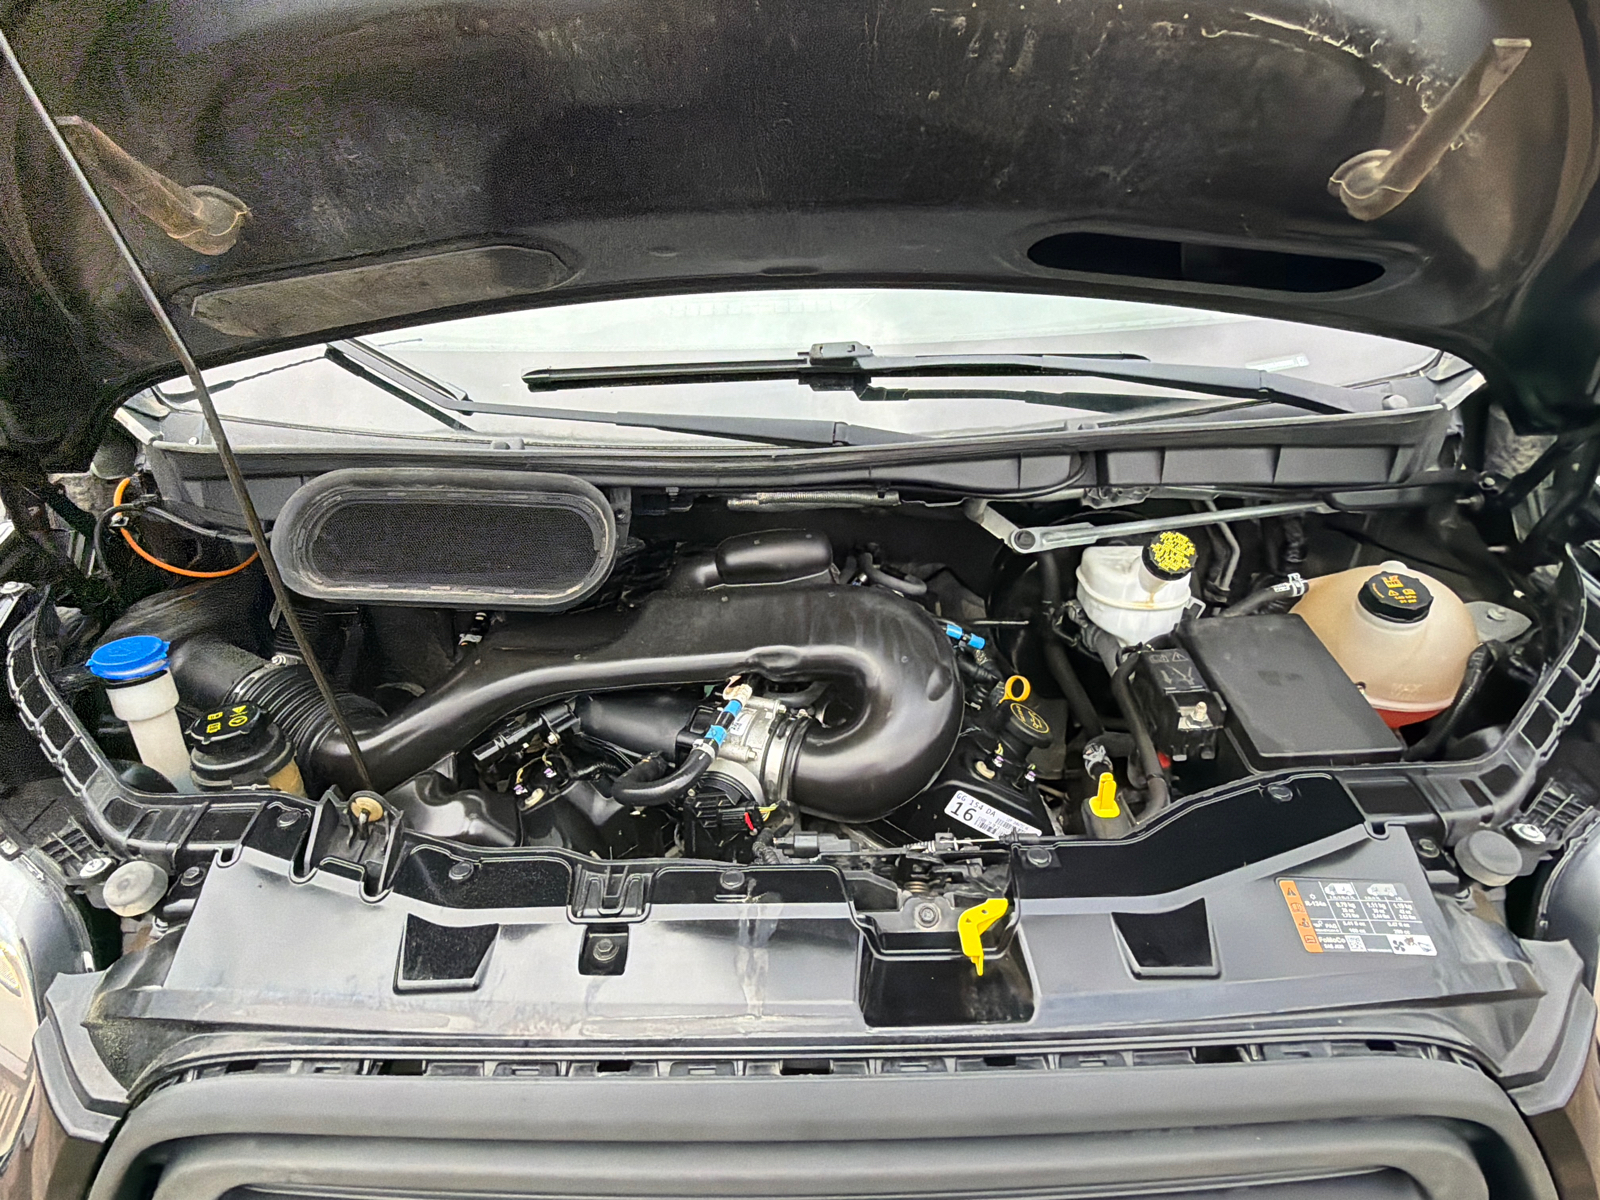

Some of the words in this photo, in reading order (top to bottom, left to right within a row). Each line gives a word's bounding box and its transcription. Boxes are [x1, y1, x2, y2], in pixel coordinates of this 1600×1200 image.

[950, 802, 977, 822] 16
[956, 792, 966, 802] GG
[969, 800, 983, 810] 154
[986, 808, 996, 817] DA
